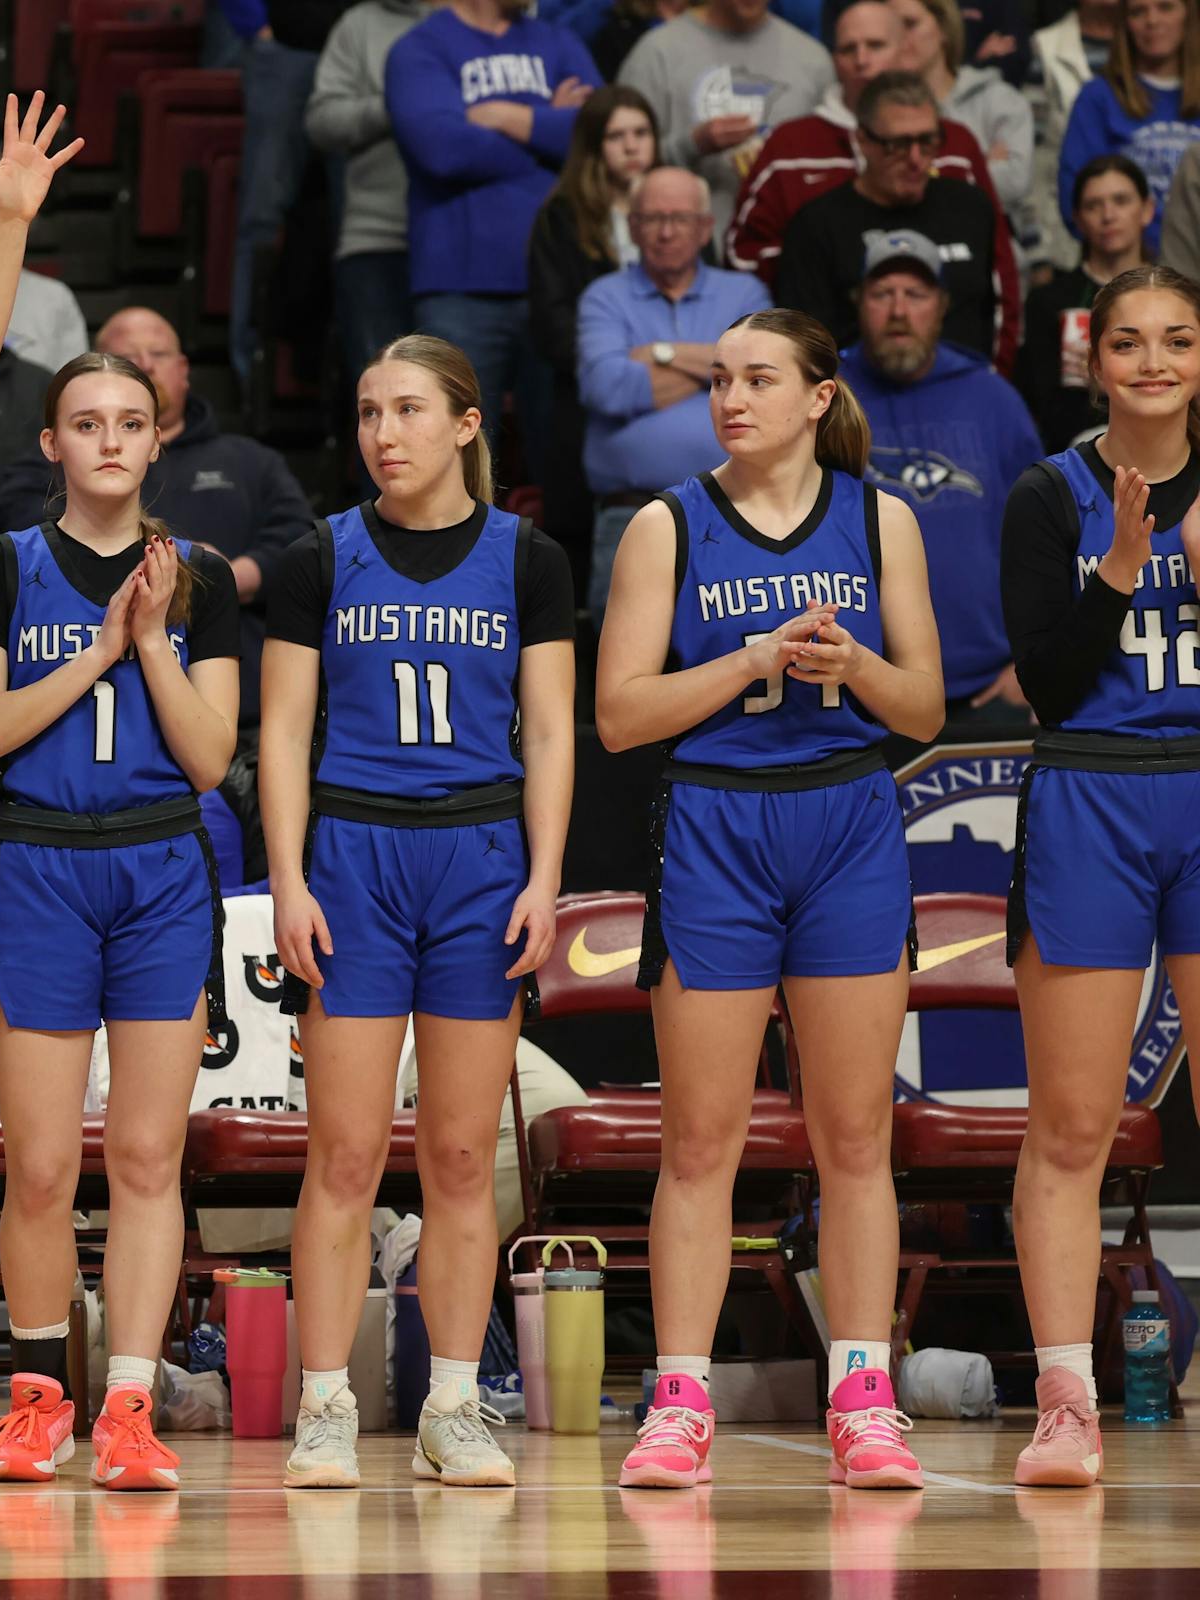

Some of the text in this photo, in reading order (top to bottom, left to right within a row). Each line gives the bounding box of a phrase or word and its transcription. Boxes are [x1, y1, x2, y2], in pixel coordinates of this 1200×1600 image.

[461, 53, 553, 103] CENTRAL
[698, 571, 869, 622] MUSTANGS
[1076, 553, 1197, 593] MTA
[335, 604, 509, 651] MUSTANGS
[93, 680, 115, 762] 1
[393, 661, 454, 745] 11
[1126, 1325, 1156, 1334] ZERO
